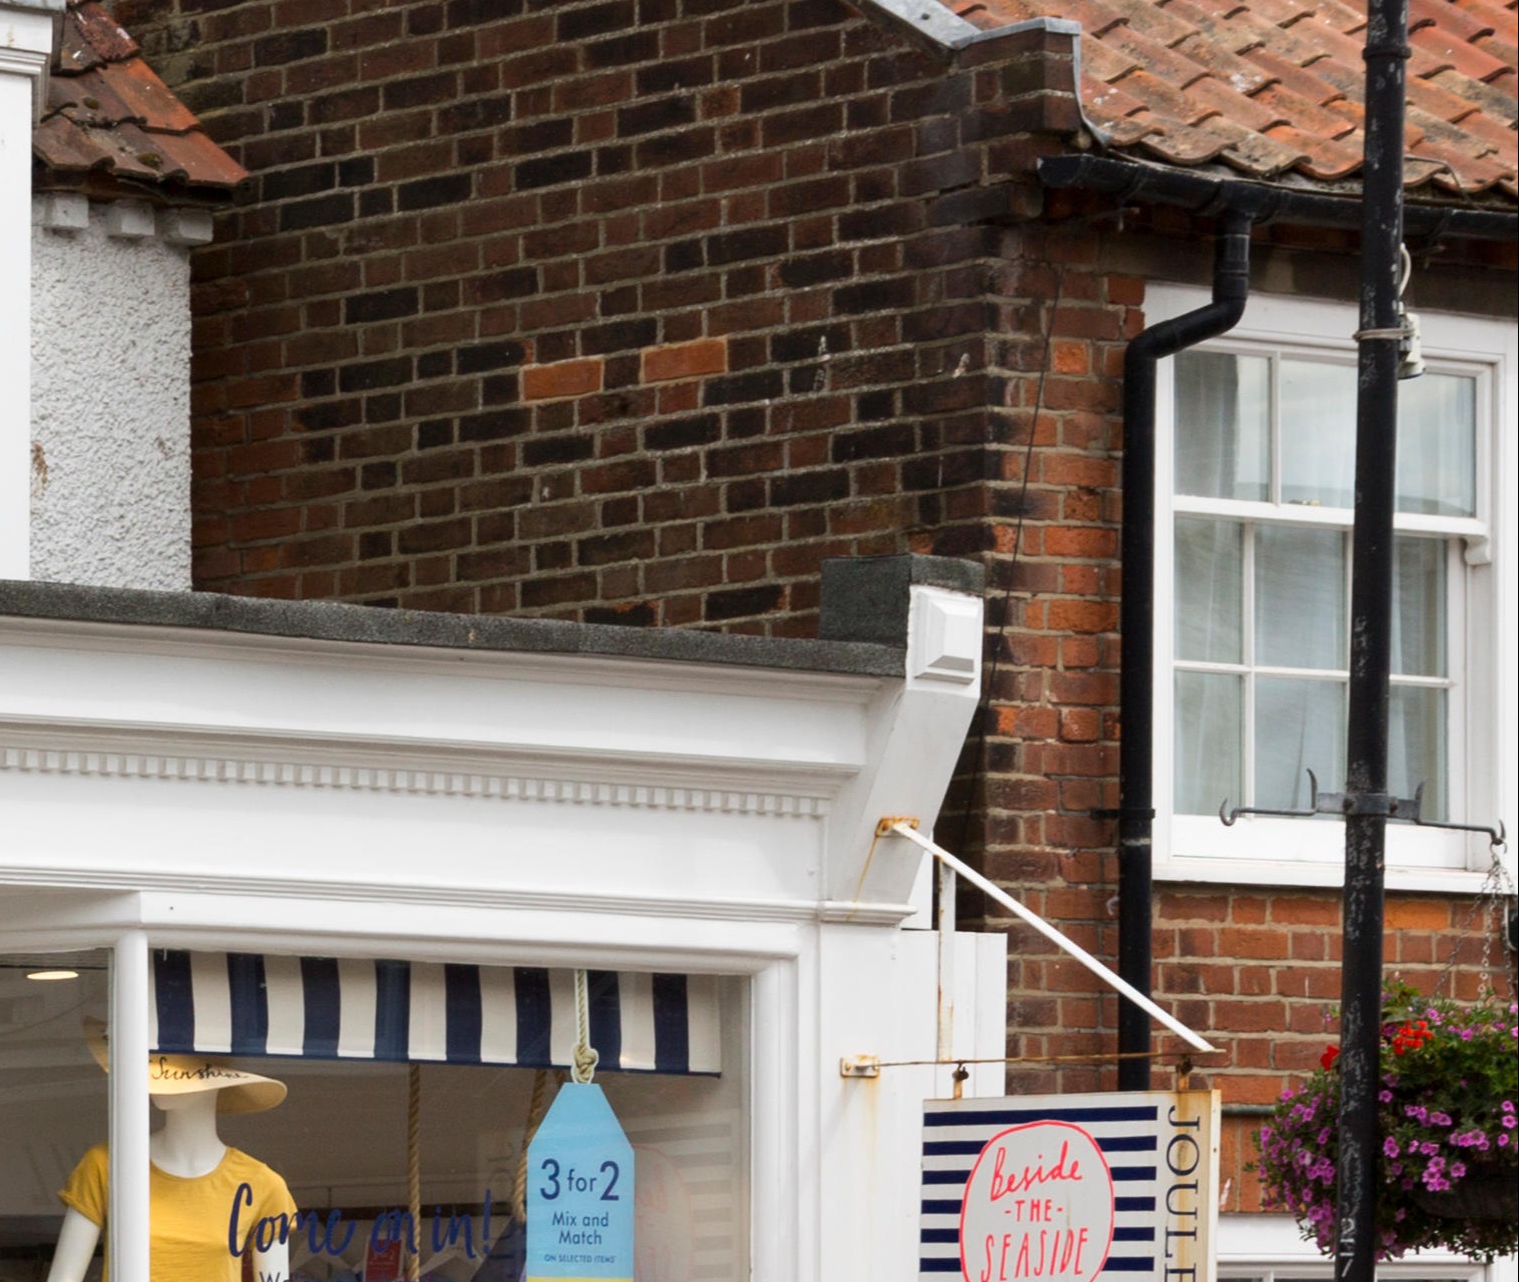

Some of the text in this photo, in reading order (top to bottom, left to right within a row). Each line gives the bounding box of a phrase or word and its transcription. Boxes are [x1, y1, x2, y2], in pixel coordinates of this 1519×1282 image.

[540, 1158, 620, 1201] 3 for 2
[228, 1183, 492, 1260] Come on in!
[551, 1211, 609, 1228] Mix and
[558, 1230, 603, 1245] Match
[544, 1254, 556, 1263] ON
[558, 1254, 592, 1264] SELECTED
